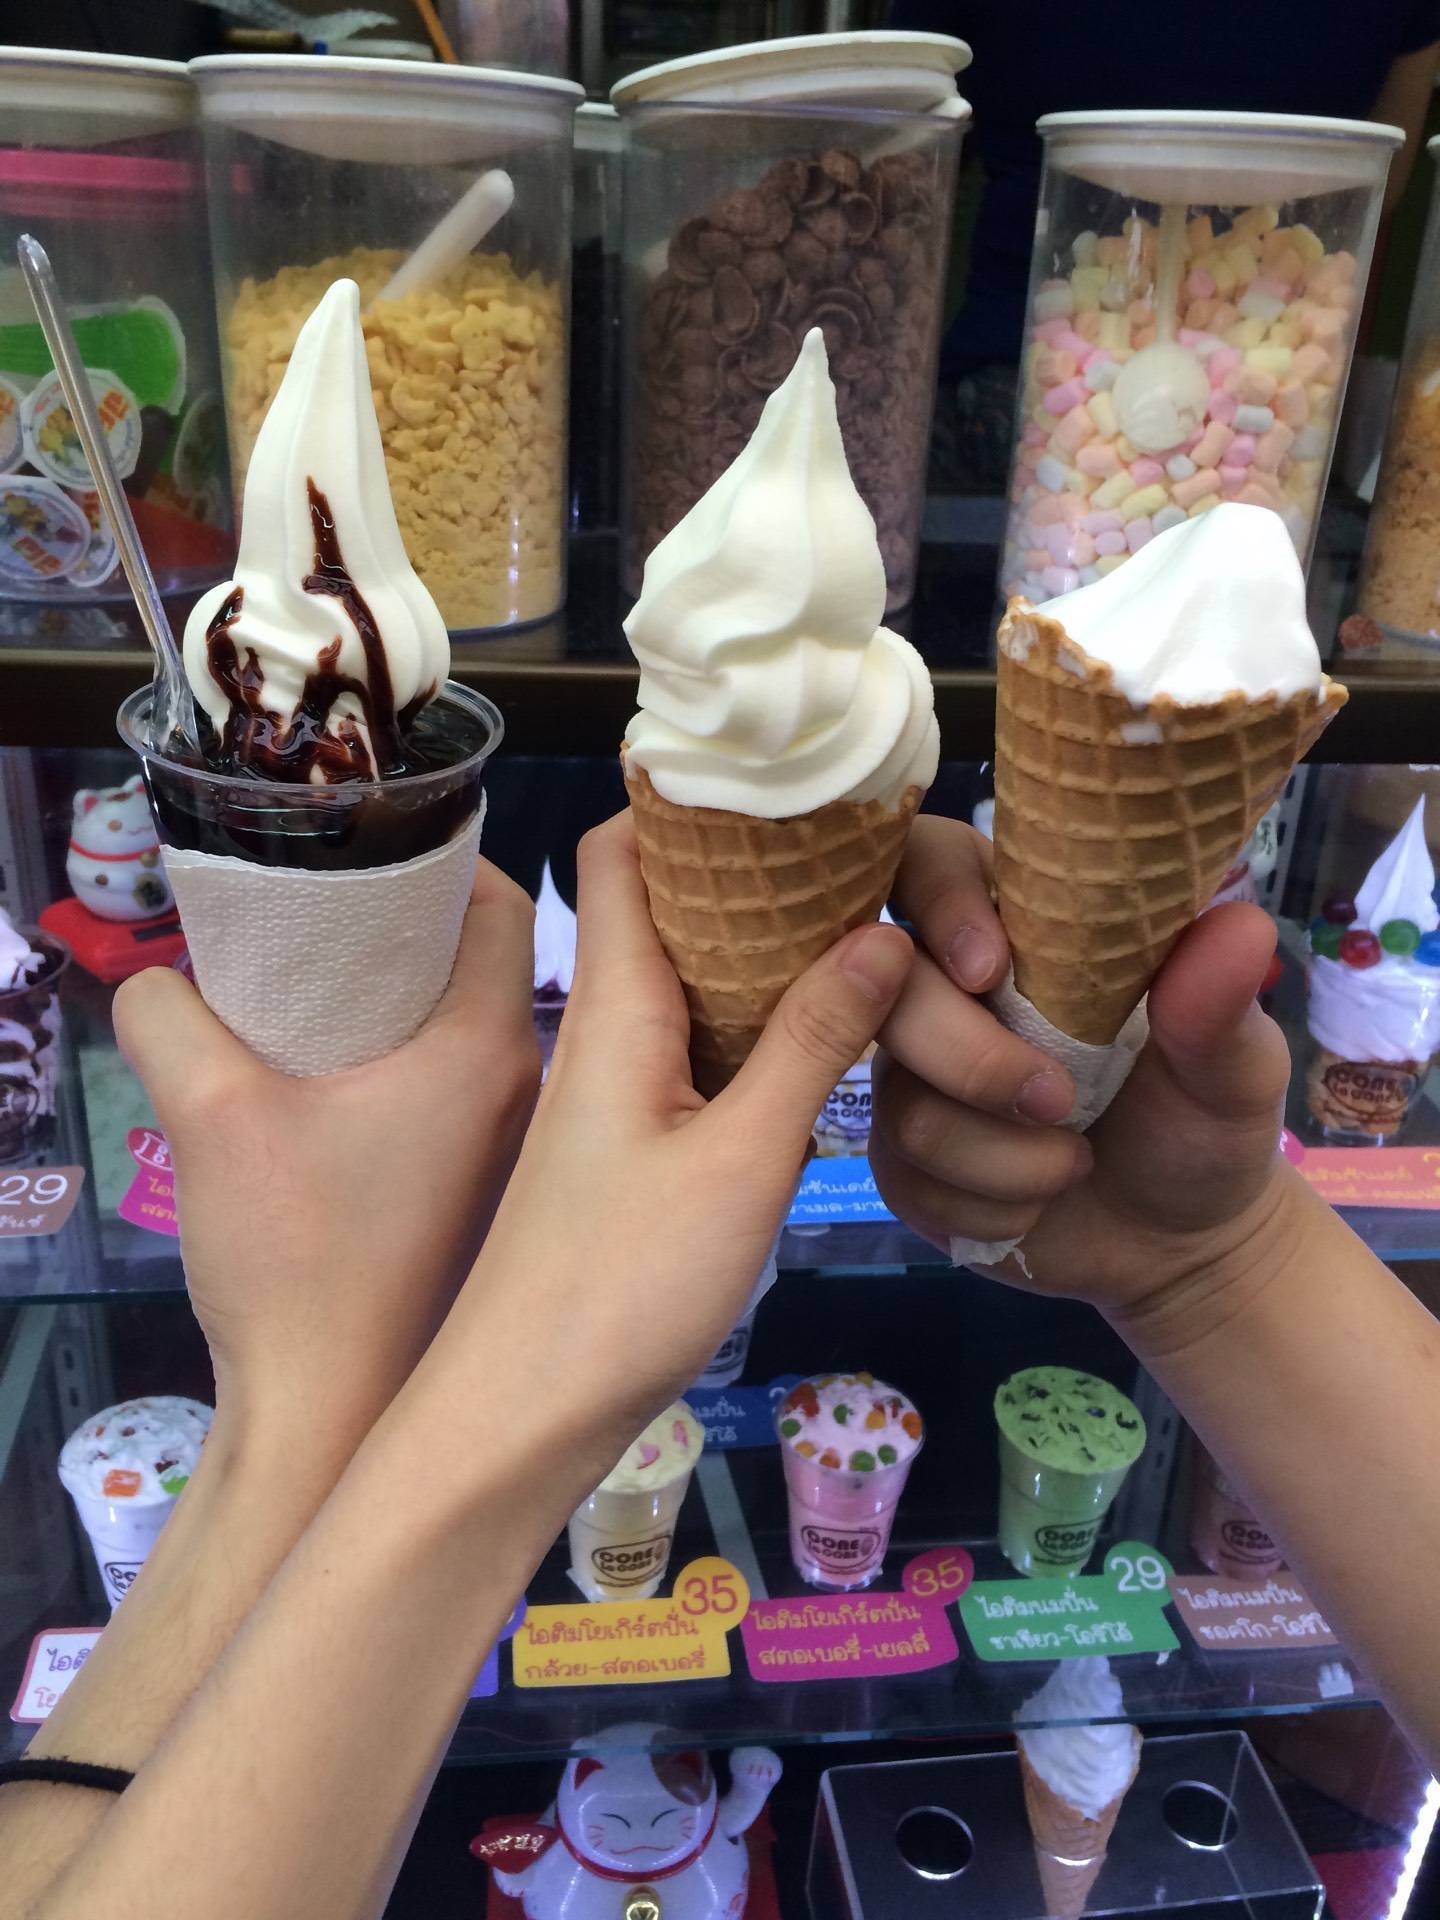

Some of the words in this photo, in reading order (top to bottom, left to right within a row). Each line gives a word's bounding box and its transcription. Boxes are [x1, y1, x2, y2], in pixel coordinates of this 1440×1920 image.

[0, 1174, 68, 1205] 29
[600, 1547, 654, 1563] CONE
[807, 1530, 859, 1549] CONE
[912, 1557, 964, 1596] 35
[1111, 1556, 1166, 1592] 29
[682, 1574, 738, 1615] 35
